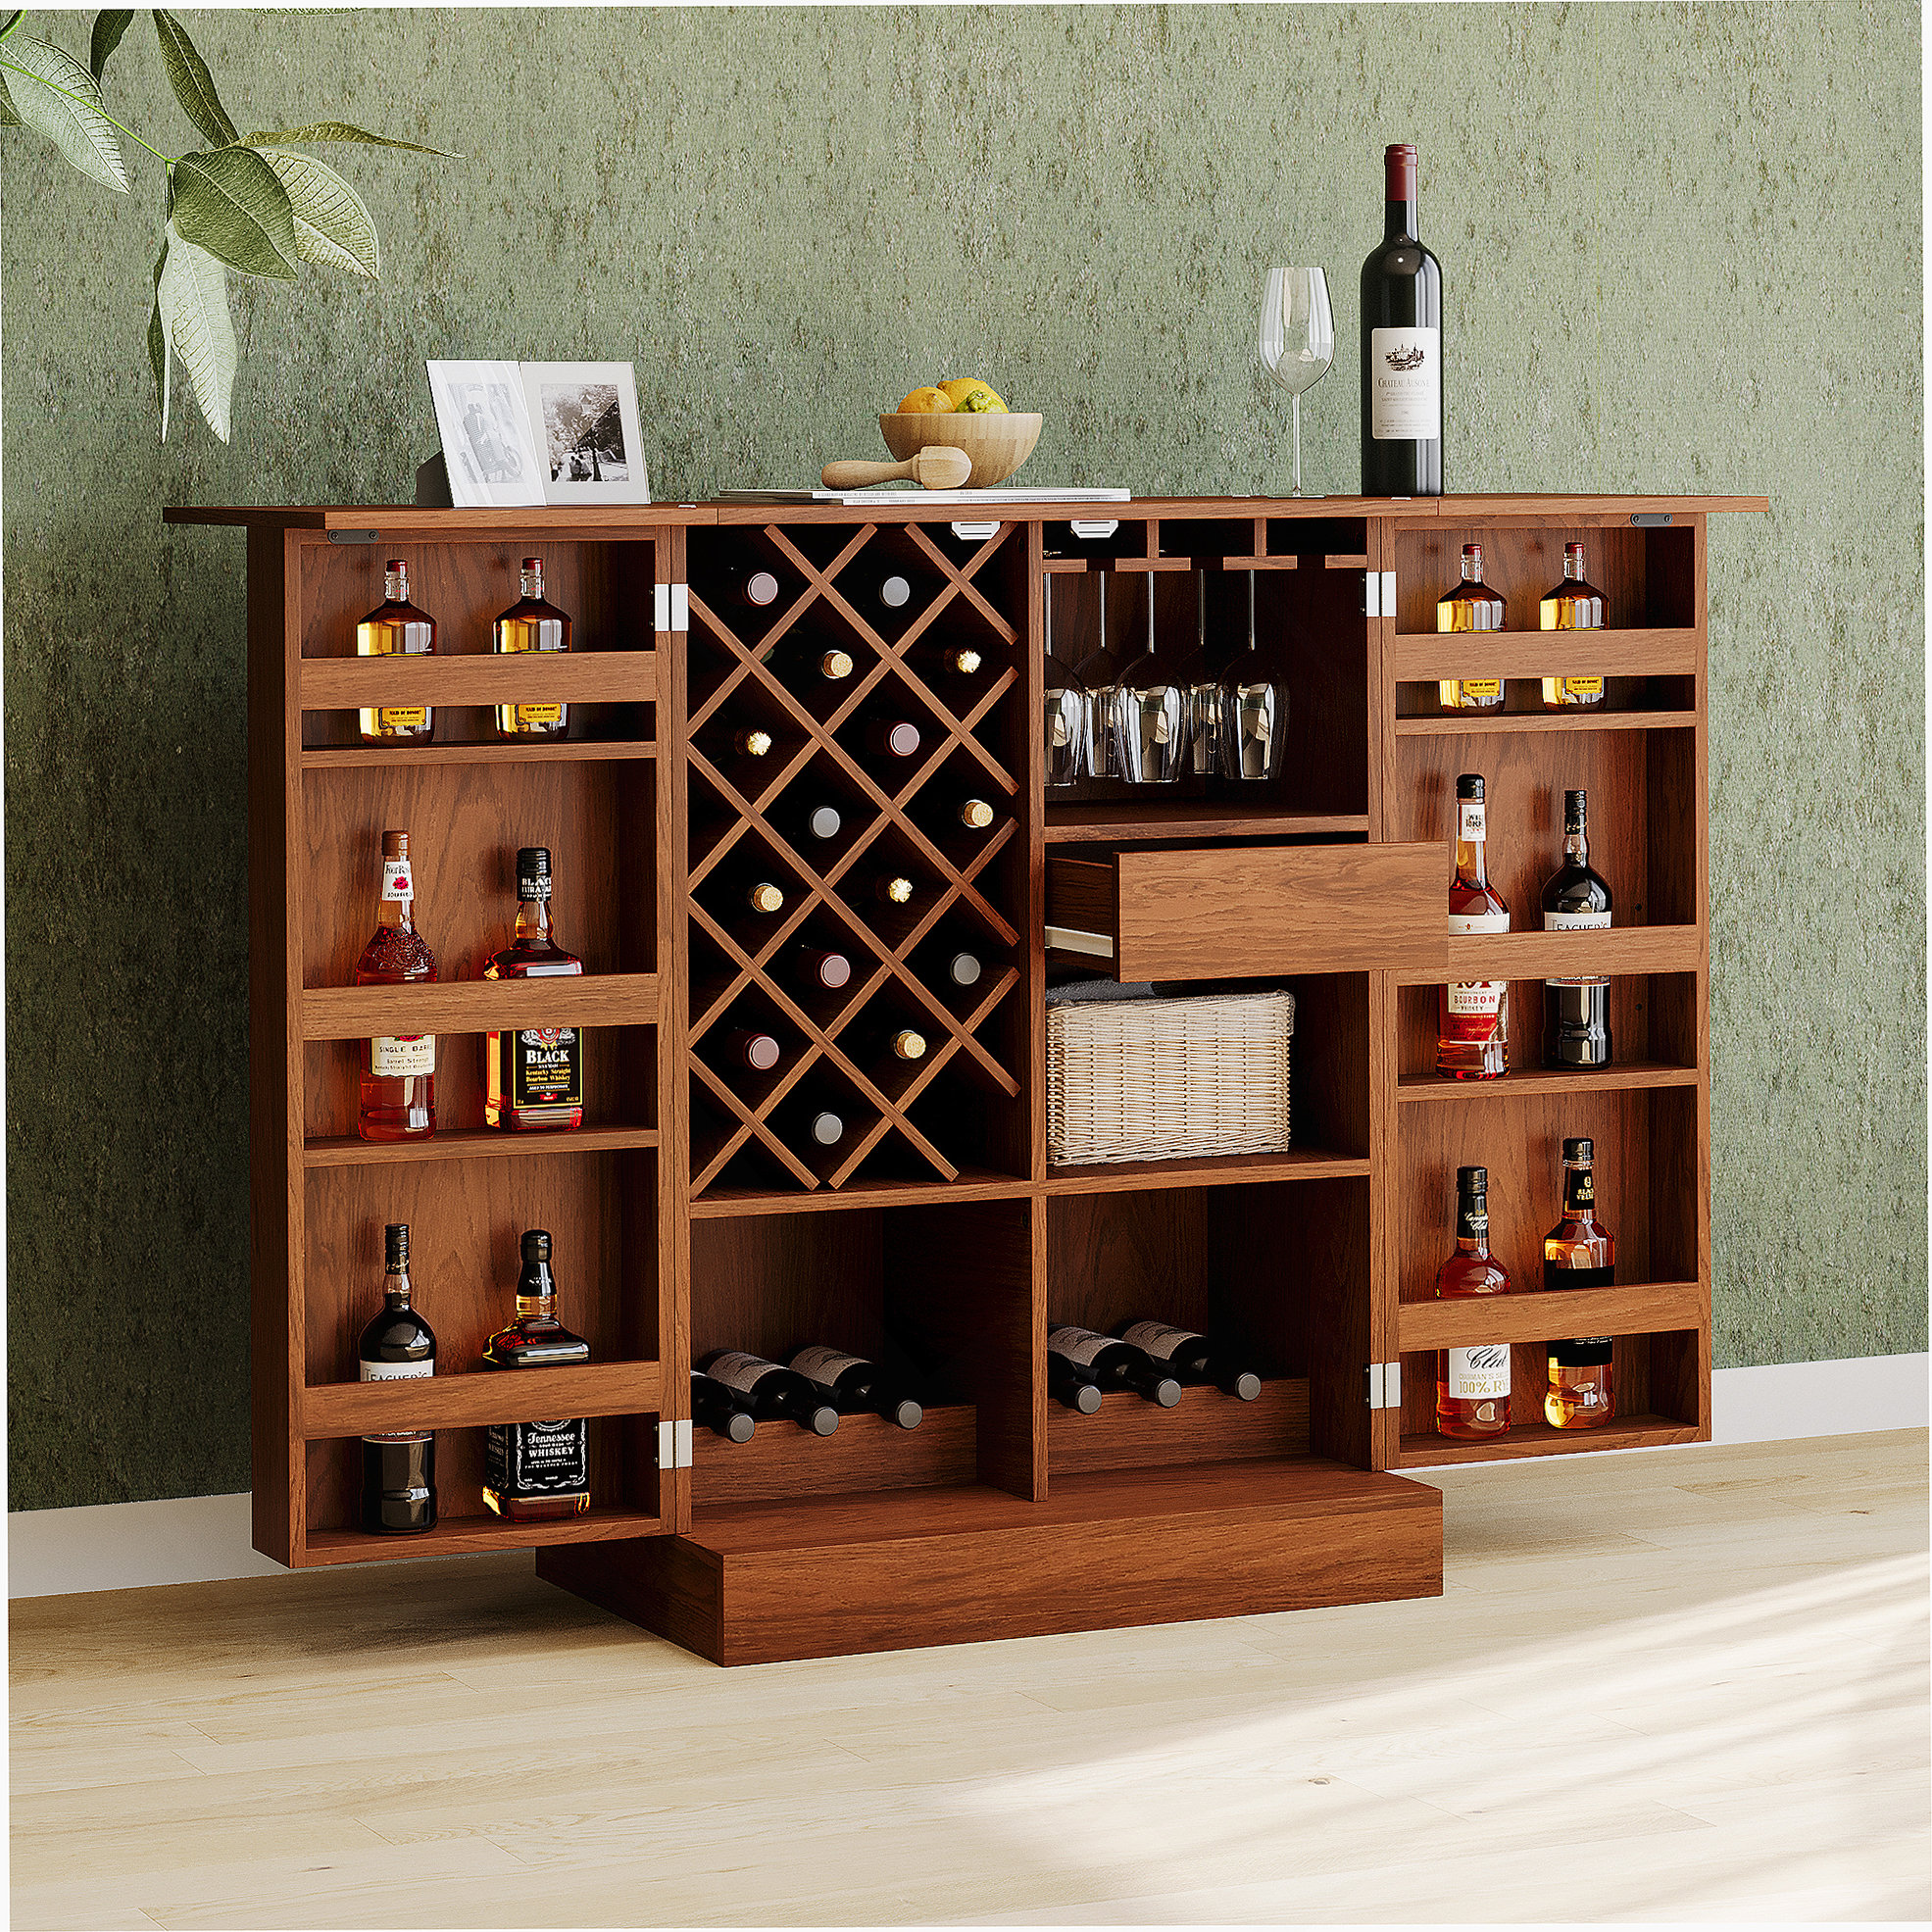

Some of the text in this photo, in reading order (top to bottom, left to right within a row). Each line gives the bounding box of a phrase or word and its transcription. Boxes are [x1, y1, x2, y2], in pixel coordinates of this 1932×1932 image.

[521, 877, 552, 886] BLAC
[1454, 995, 1496, 1004] BOURBON
[525, 1050, 570, 1064] BLACK
[1459, 1380, 1491, 1394] 100%
[527, 1432, 575, 1444] Tennessee
[529, 1447, 574, 1458] WHISKEY
